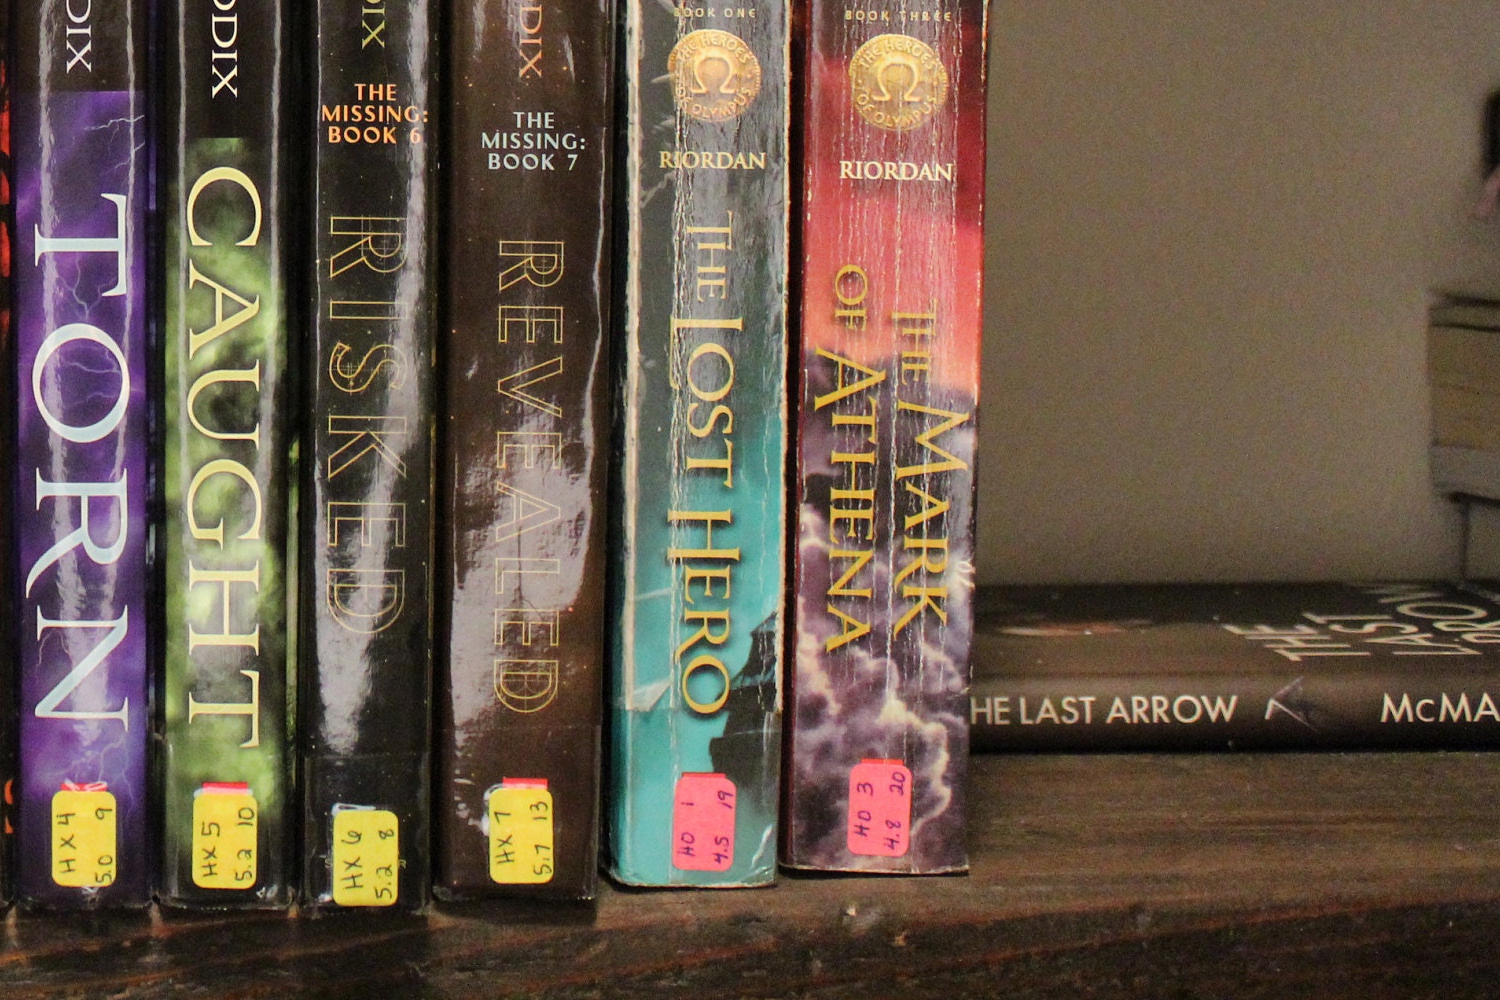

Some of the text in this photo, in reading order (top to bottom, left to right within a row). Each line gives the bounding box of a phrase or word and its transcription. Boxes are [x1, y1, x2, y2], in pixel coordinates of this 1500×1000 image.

[673, 7, 756, 18] BOOK ONE
[844, 9, 952, 22] BOOK THREE
[679, 33, 750, 64] THE HEROES
[858, 38, 938, 71] THE HEROES
[354, 83, 397, 101] THE
[692, 87, 751, 119] OLYMPUS
[856, 92, 937, 128] OF OLYMPUS
[321, 105, 428, 123] MISSING:
[513, 111, 555, 129] THE
[328, 126, 422, 144] BOOK 6
[481, 132, 586, 151] MISSING:
[488, 153, 579, 171] BOOK 7
[659, 150, 766, 170] RIORDAN
[839, 160, 953, 181] RIORDAN
[325, 215, 408, 635] RISKED
[25, 192, 131, 730] TORN
[186, 166, 263, 750] CAUGHT
[666, 210, 743, 715] THE LOST HERO
[813, 263, 887, 653] OF ATHENA
[890, 298, 970, 637] THE MARK
[493, 240, 565, 713] REVEALED
[970, 695, 1238, 725] HE LAST ARROW
[856, 782, 874, 797] 3
[56, 812, 76, 826] 4
[201, 822, 221, 837] 5
[341, 830, 362, 844] 6
